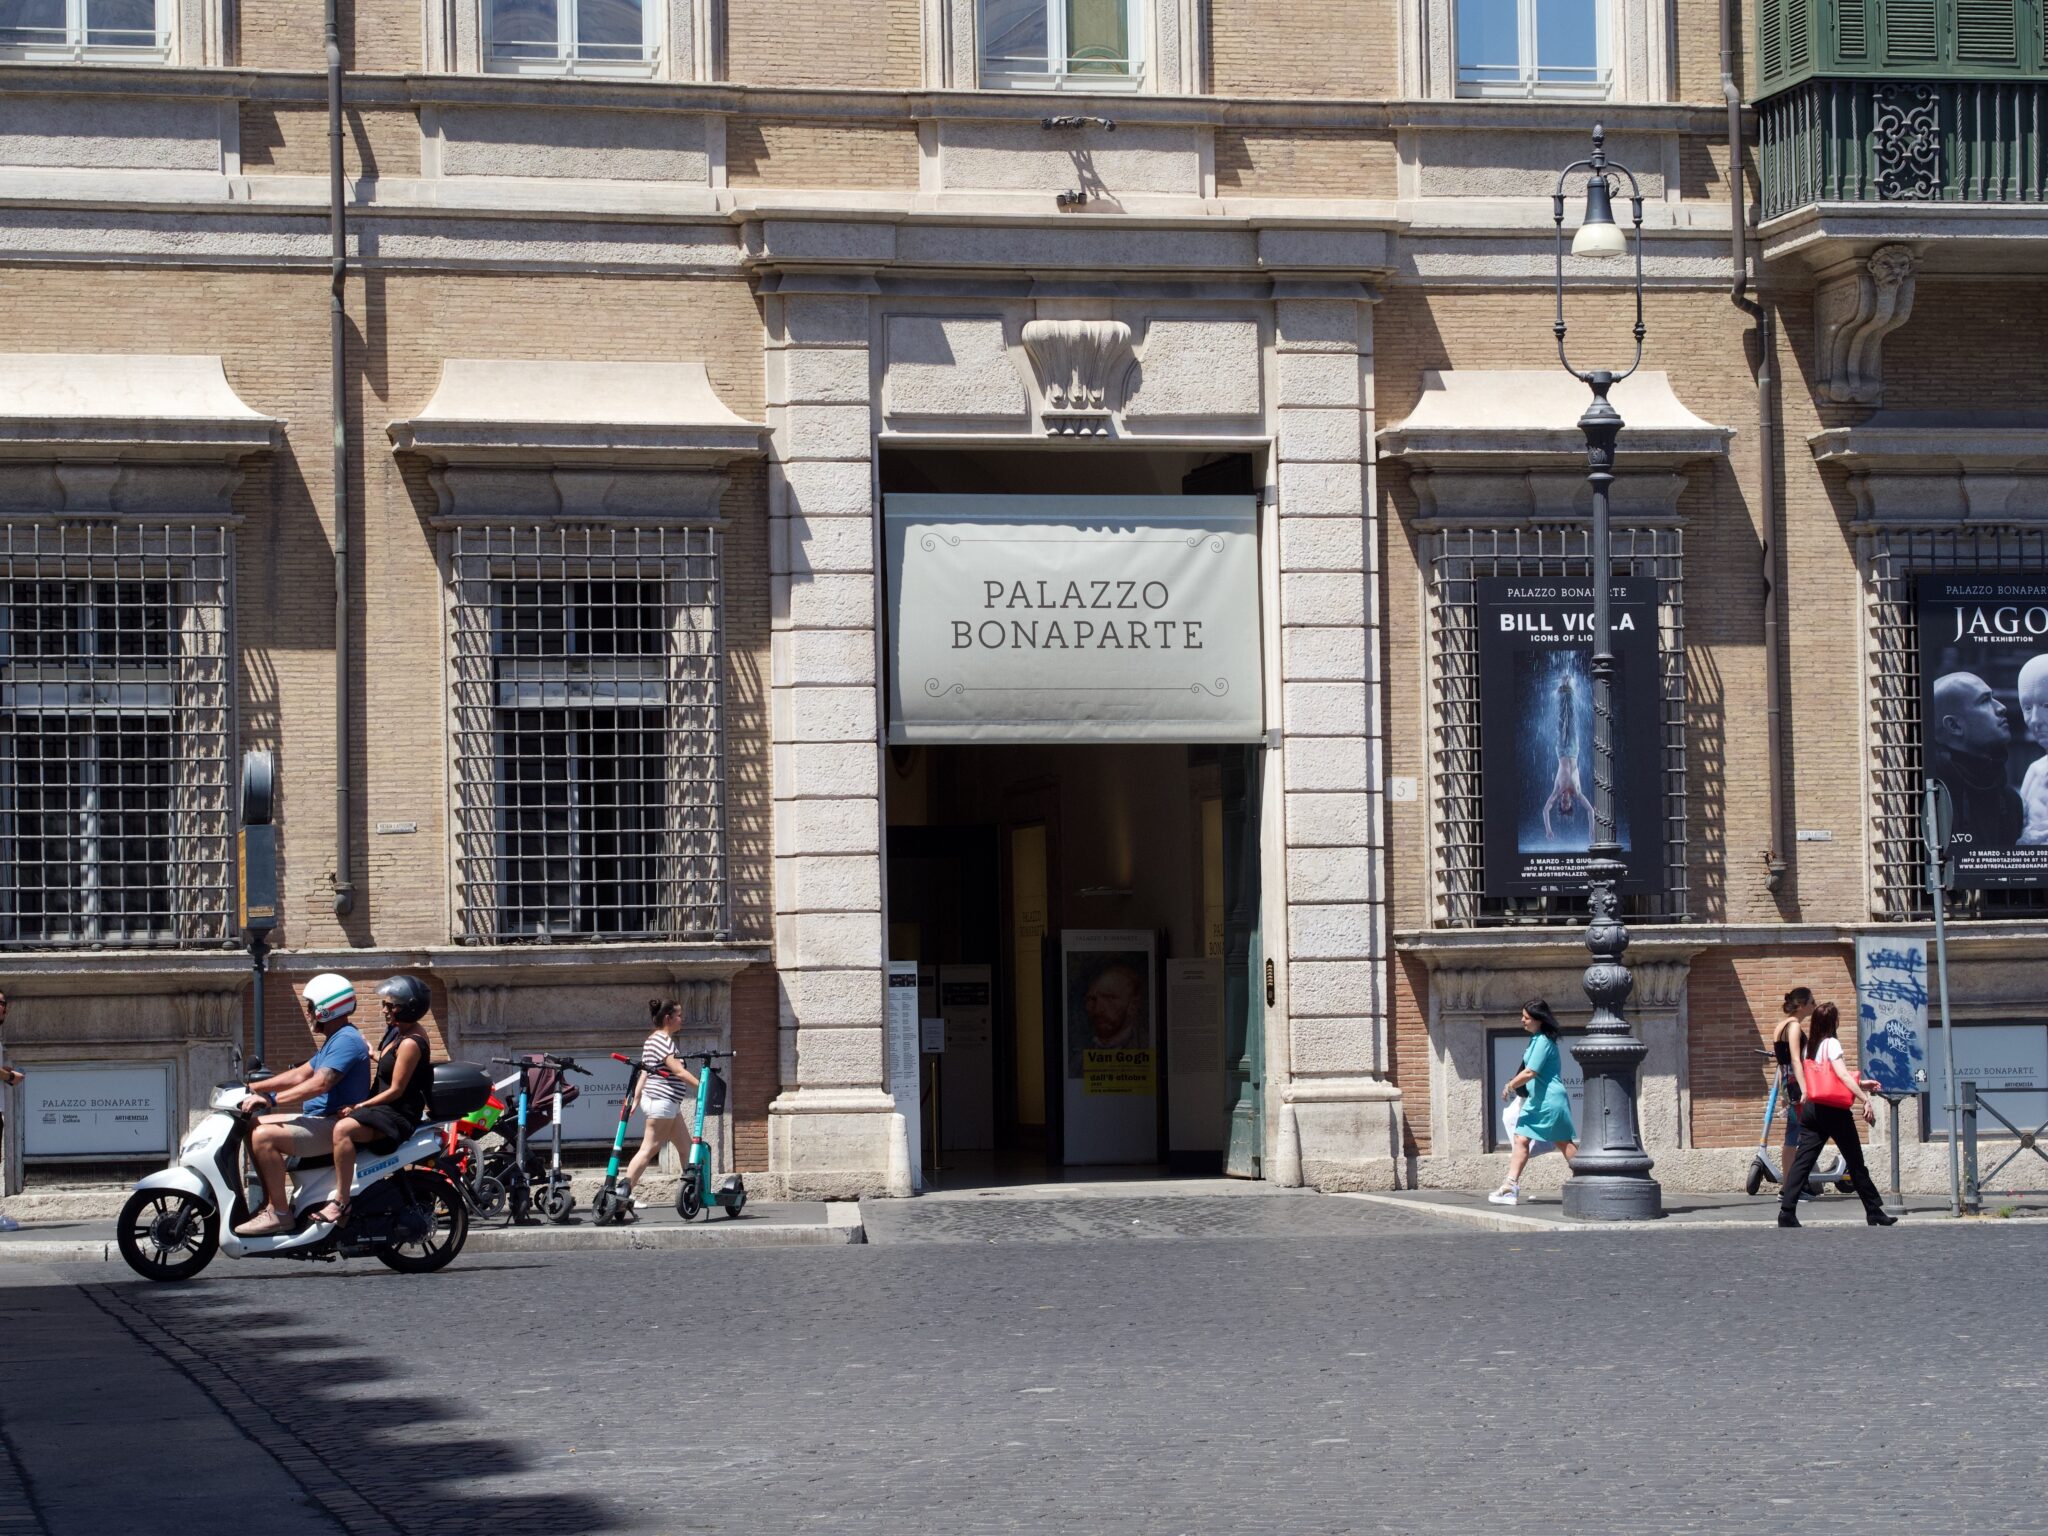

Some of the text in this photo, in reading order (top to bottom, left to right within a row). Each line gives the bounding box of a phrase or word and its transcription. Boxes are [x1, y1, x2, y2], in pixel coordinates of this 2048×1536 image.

[983, 580, 1170, 610] PALAZZO
[1507, 587, 1627, 597] PALAZZO BONATE
[1946, 586, 2048, 595] PALAZZO BONAPAR
[1500, 613, 1553, 631] BILL
[1953, 606, 2048, 642] JAGO
[950, 620, 1204, 649] BONAPARTE
[1530, 634, 1559, 642] ICONS
[1562, 634, 1575, 642] OF
[1396, 780, 1407, 798] 5
[1088, 1051, 1150, 1065] Van Gogh
[1943, 1067, 2034, 1076] LAZZO BONAPARTE
[42, 1099, 150, 1108] PALAZZO BONAPARTE
